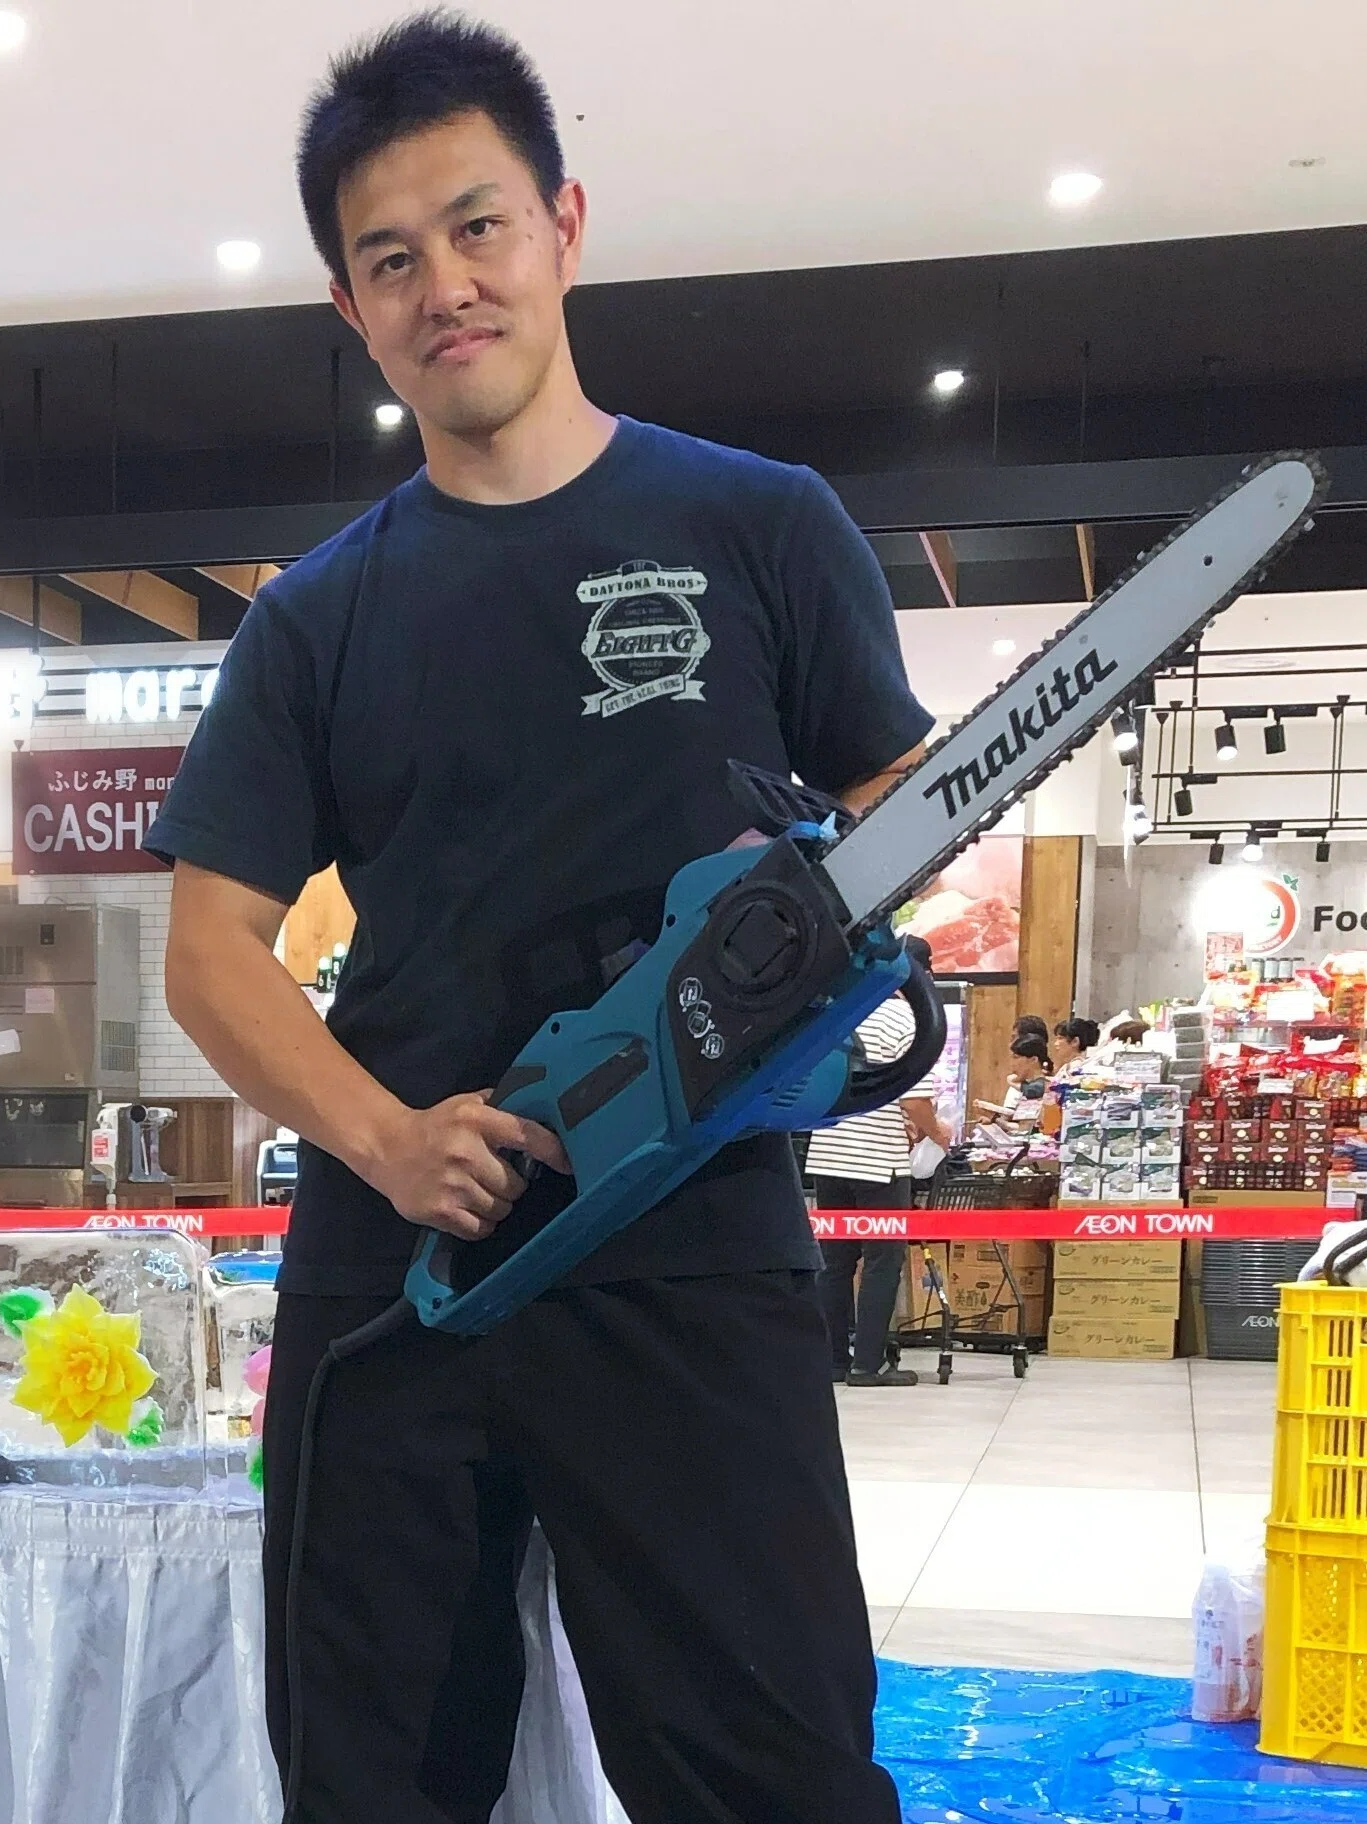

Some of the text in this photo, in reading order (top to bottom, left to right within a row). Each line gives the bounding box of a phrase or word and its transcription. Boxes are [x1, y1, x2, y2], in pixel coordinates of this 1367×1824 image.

[589, 577, 693, 596] DAYTONA BROS
[48, 768, 137, 792] ふじみ野
[142, 1214, 203, 1233] TOWN
[842, 1216, 907, 1235] TOWN
[1144, 1214, 1213, 1233] TOWN
[1091, 1256, 1163, 1265] グリーンカレー
[1091, 1295, 1160, 1305] グリーンカレー
[1085, 1334, 1155, 1344] グリーンカレー
